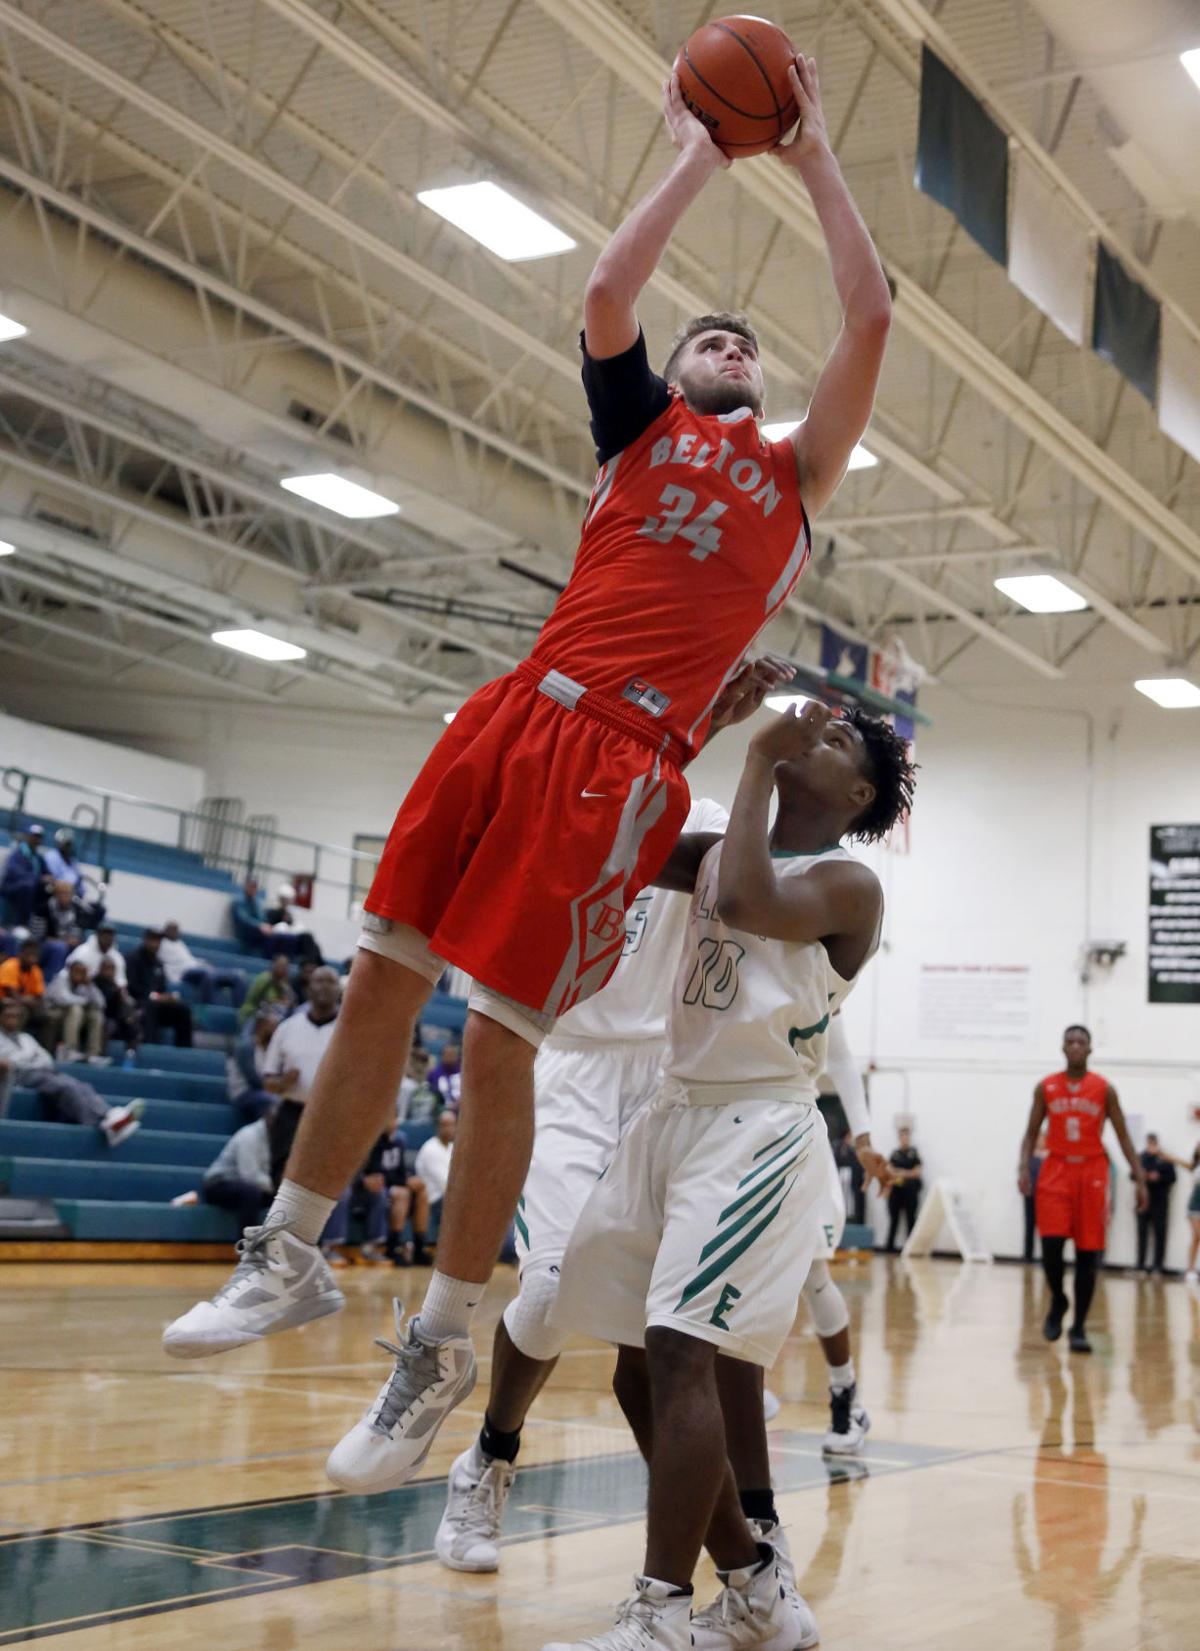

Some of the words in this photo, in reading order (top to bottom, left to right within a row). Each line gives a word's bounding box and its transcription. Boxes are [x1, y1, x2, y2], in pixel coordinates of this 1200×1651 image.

[649, 434, 783, 518] BELTON
[636, 483, 729, 561] 34
[589, 901, 625, 942] B
[683, 937, 746, 1011] 10
[709, 1282, 742, 1332] E
